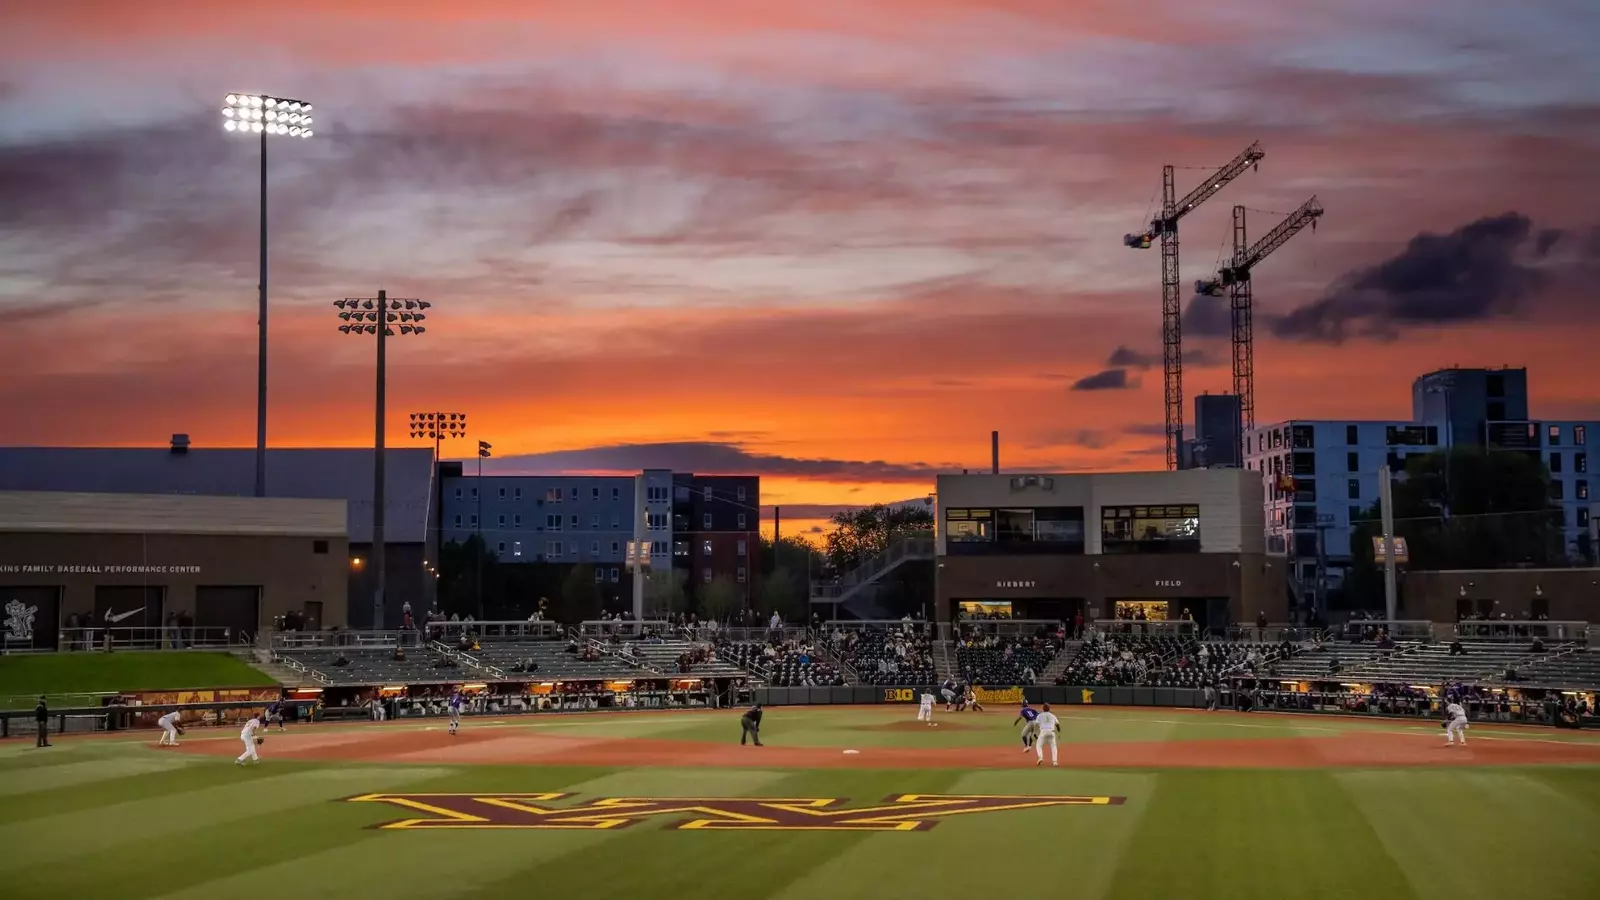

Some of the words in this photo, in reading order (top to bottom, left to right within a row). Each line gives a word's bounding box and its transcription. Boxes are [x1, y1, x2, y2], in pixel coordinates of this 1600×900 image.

[22, 565, 55, 573] FAMILY
[57, 565, 102, 573] BASEBALL
[104, 565, 167, 573] PERFORMANCE
[169, 565, 201, 573] CENTER
